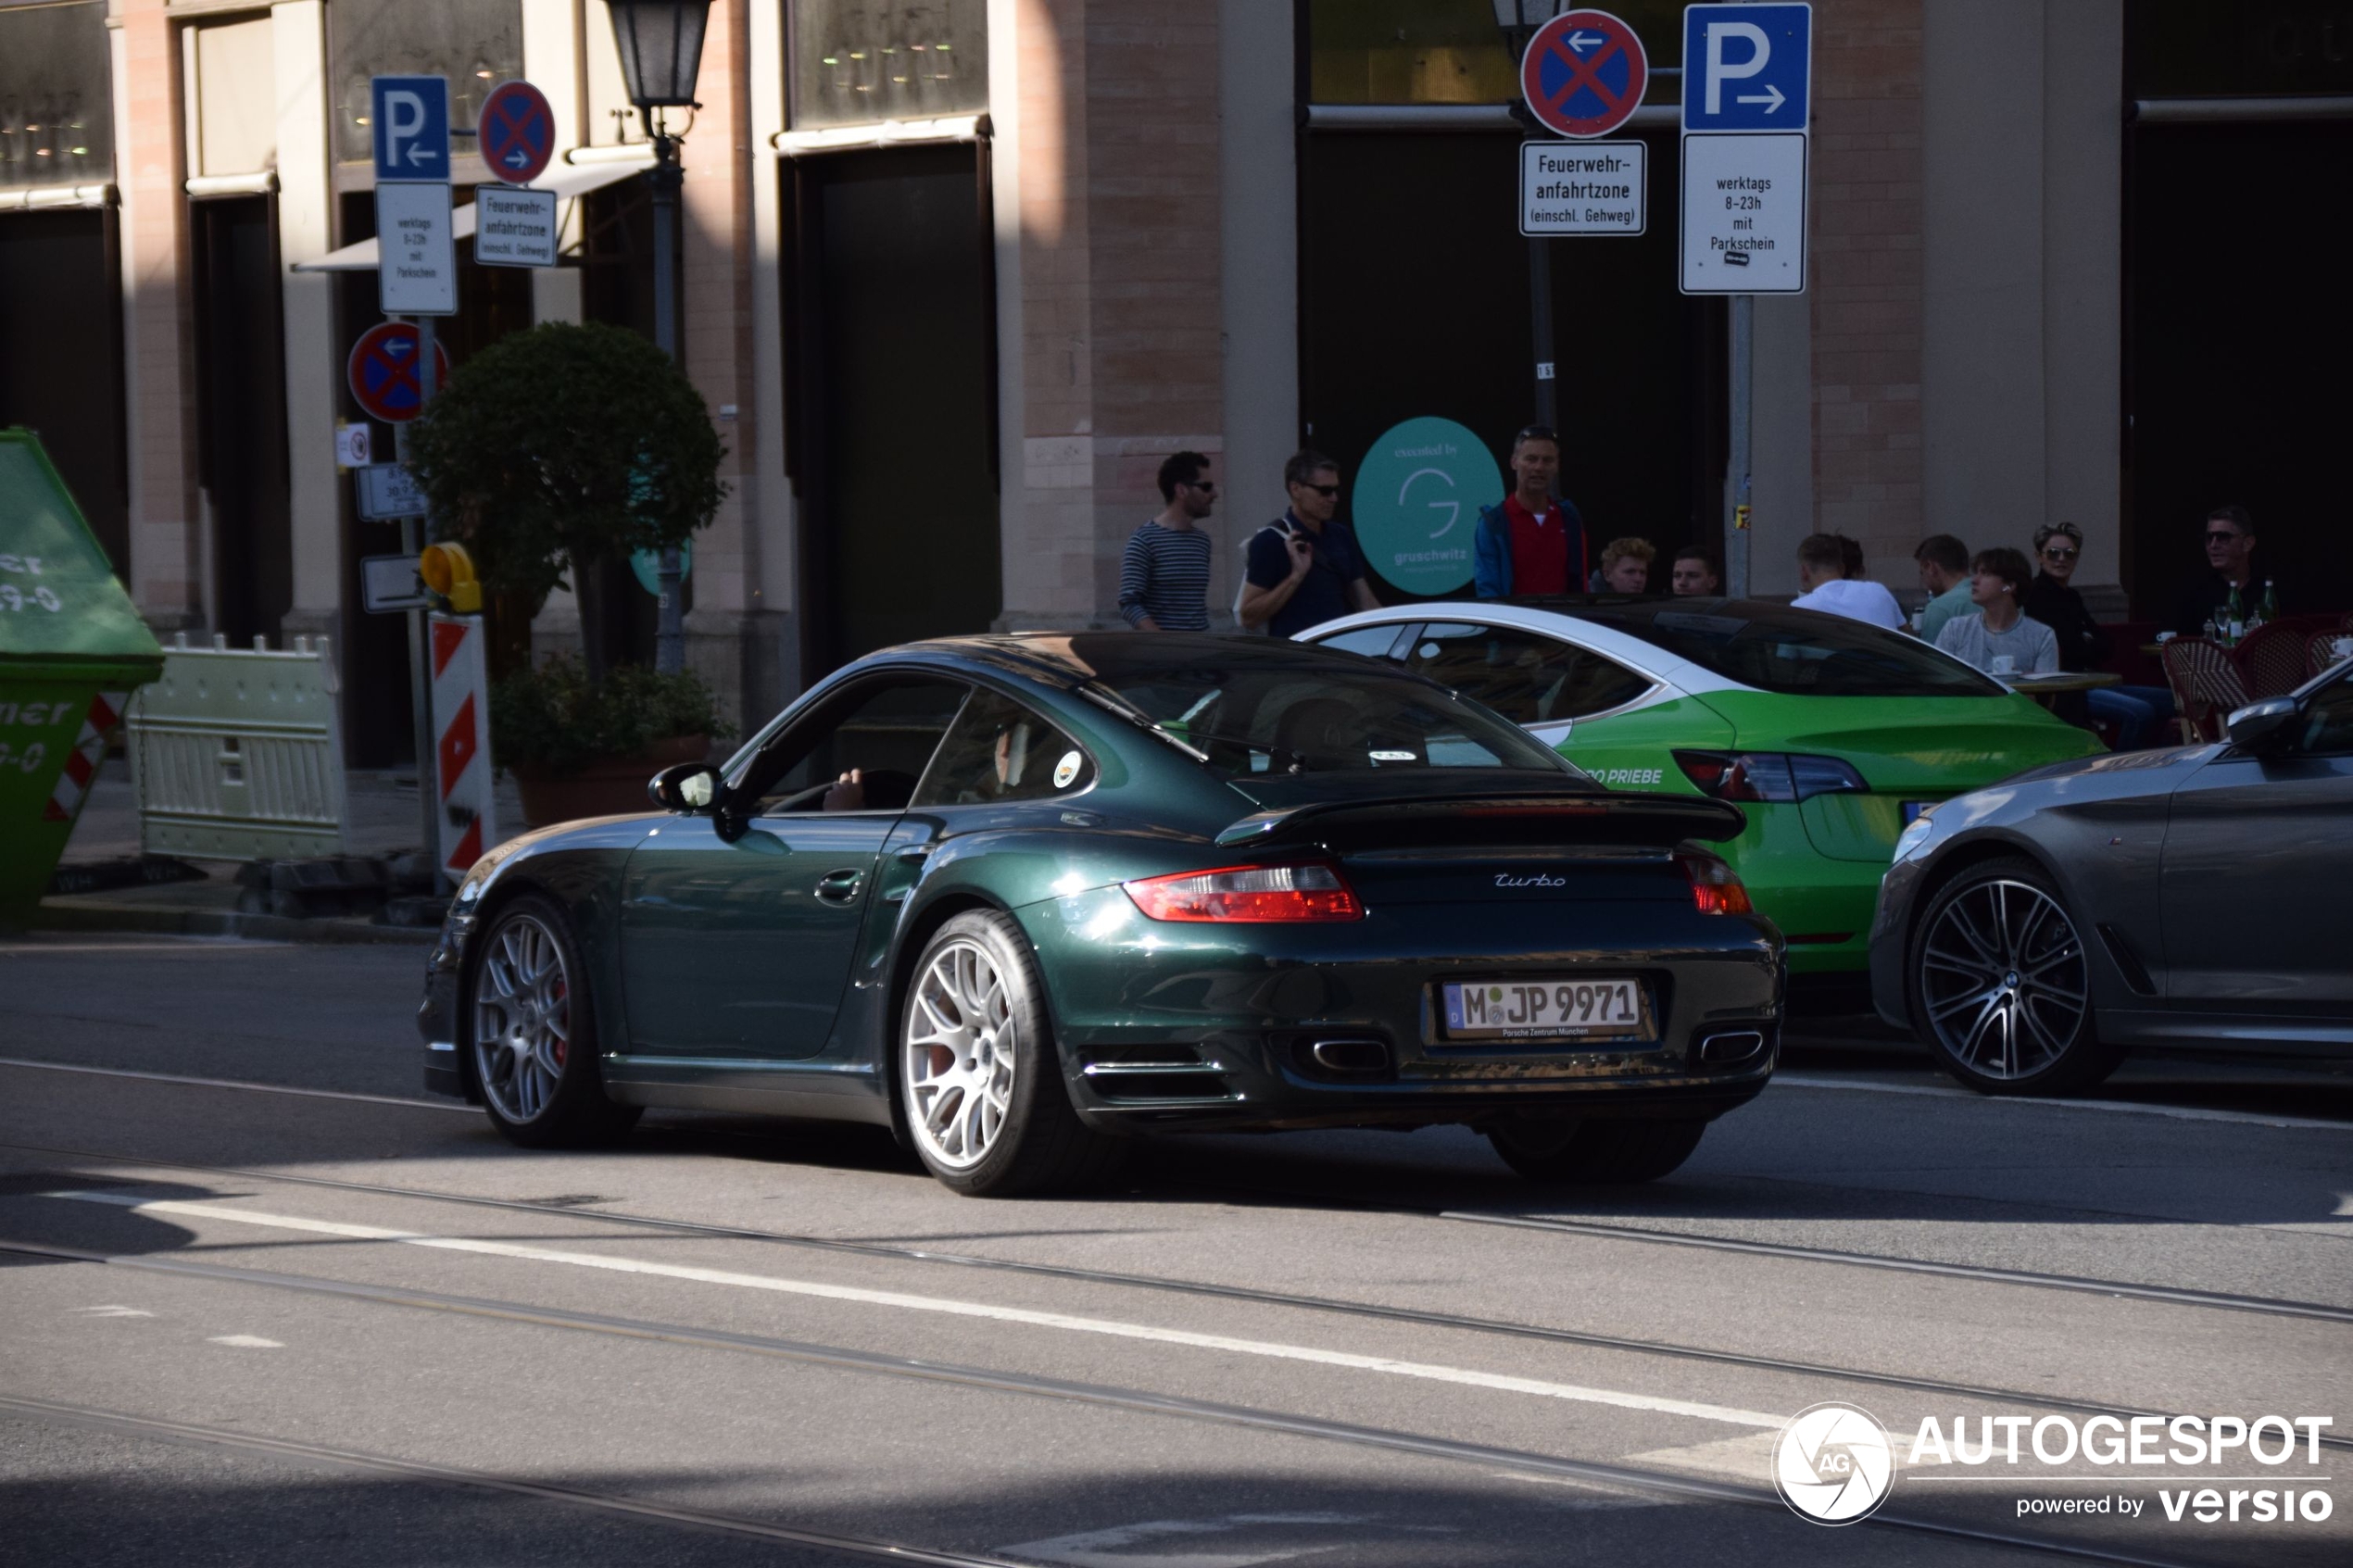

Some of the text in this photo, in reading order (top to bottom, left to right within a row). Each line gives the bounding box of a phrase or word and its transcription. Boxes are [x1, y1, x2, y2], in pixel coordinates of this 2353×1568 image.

[1705, 22, 1770, 115] P
[384, 90, 424, 167] P
[1539, 155, 1630, 173] Feuerwehr-
[1536, 182, 1630, 199] anfahrtzone
[1717, 177, 1771, 194] werktags
[486, 197, 547, 215] Feuerwehr-
[1725, 196, 1761, 210] 8-23h
[1530, 208, 1635, 226] (einschl. Gehweg)
[1733, 217, 1753, 231] mit
[484, 221, 546, 237] anfahrtzone
[1711, 236, 1775, 251] Parkschein
[1394, 548, 1466, 566] gruschwitz
[1607, 769, 1664, 784] PRIEBE
[1465, 985, 1635, 1024] M JP 9971
[1503, 1027, 1589, 1037] Porsche Zentrum München
